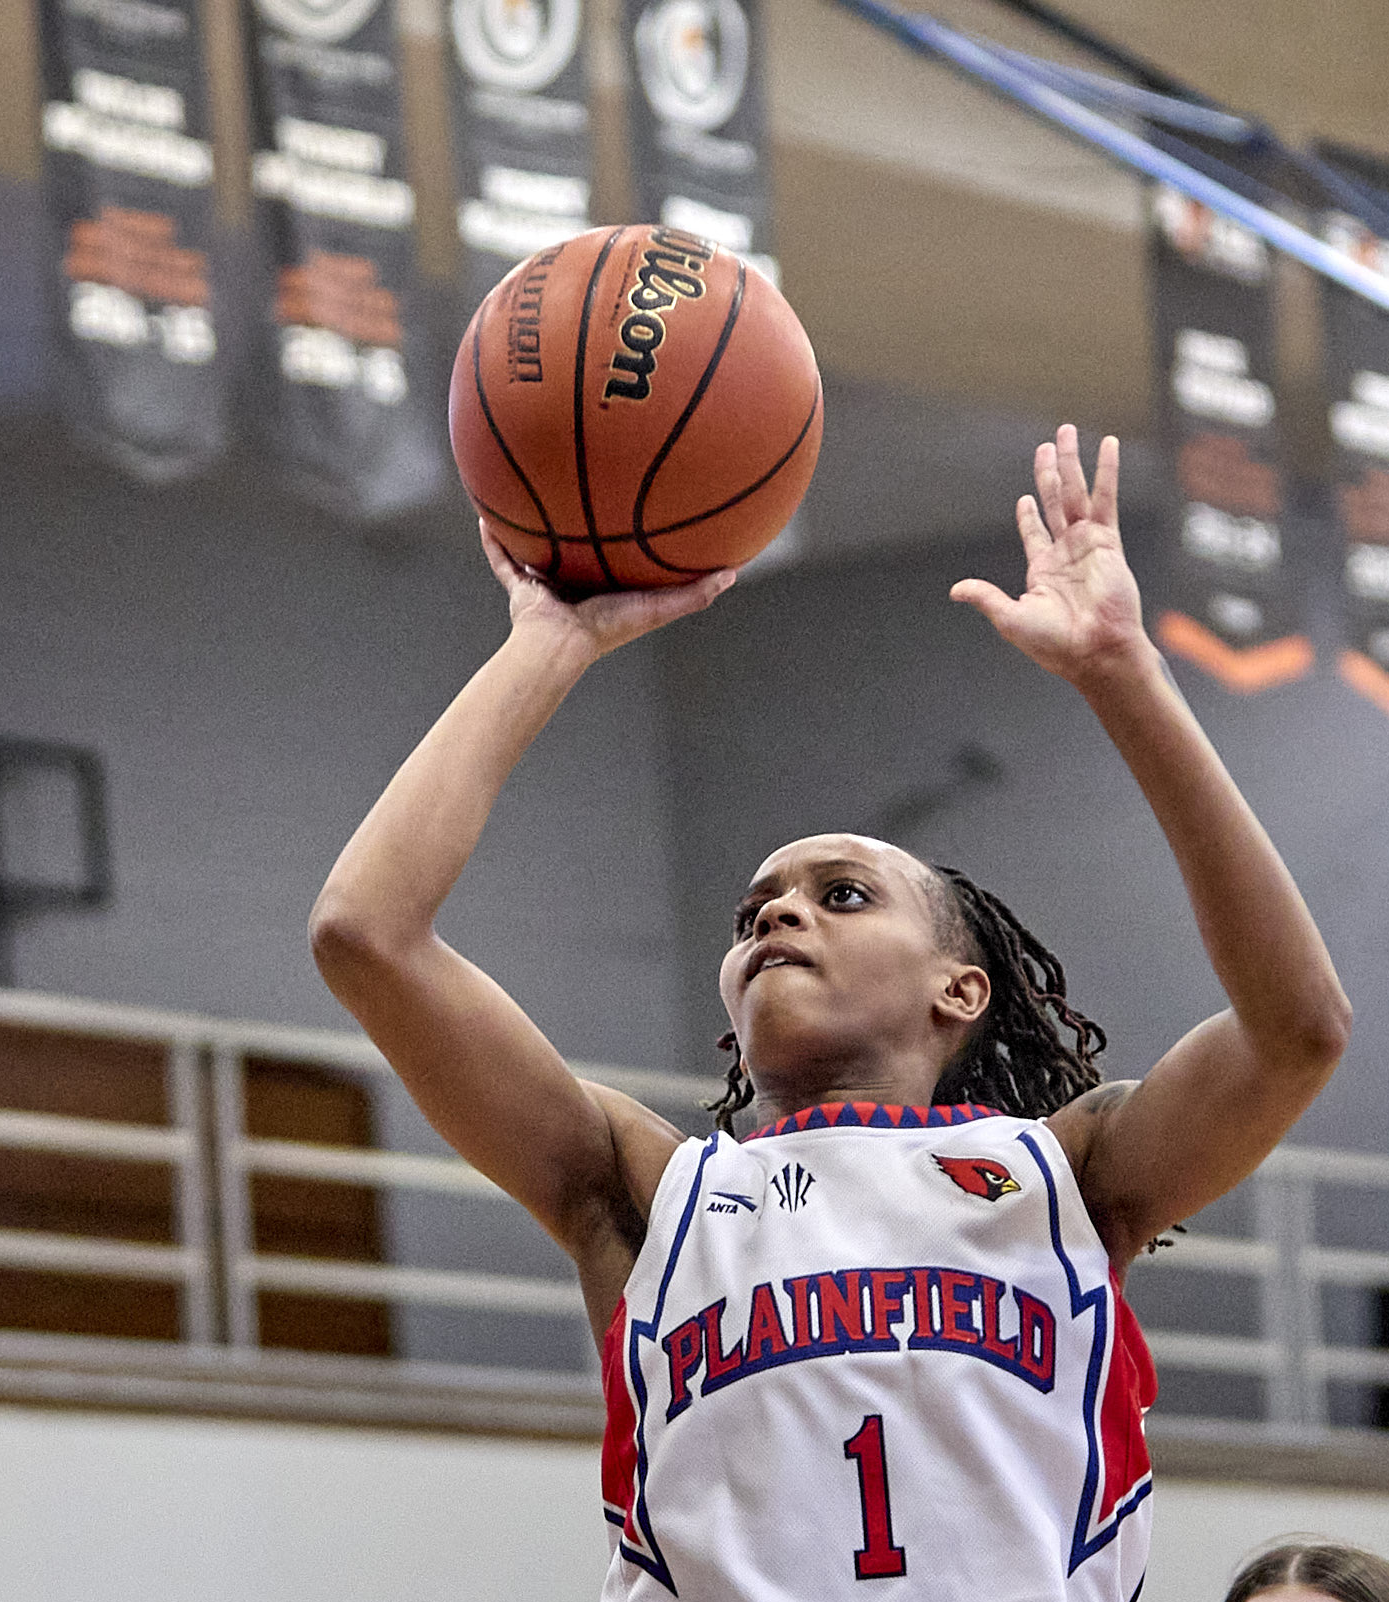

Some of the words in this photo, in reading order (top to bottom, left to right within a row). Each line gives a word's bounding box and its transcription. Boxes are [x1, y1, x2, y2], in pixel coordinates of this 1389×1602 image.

[706, 1202, 738, 1215] ANTA
[662, 1267, 1056, 1423] PLAINFIELD
[843, 1414, 907, 1580] 1
